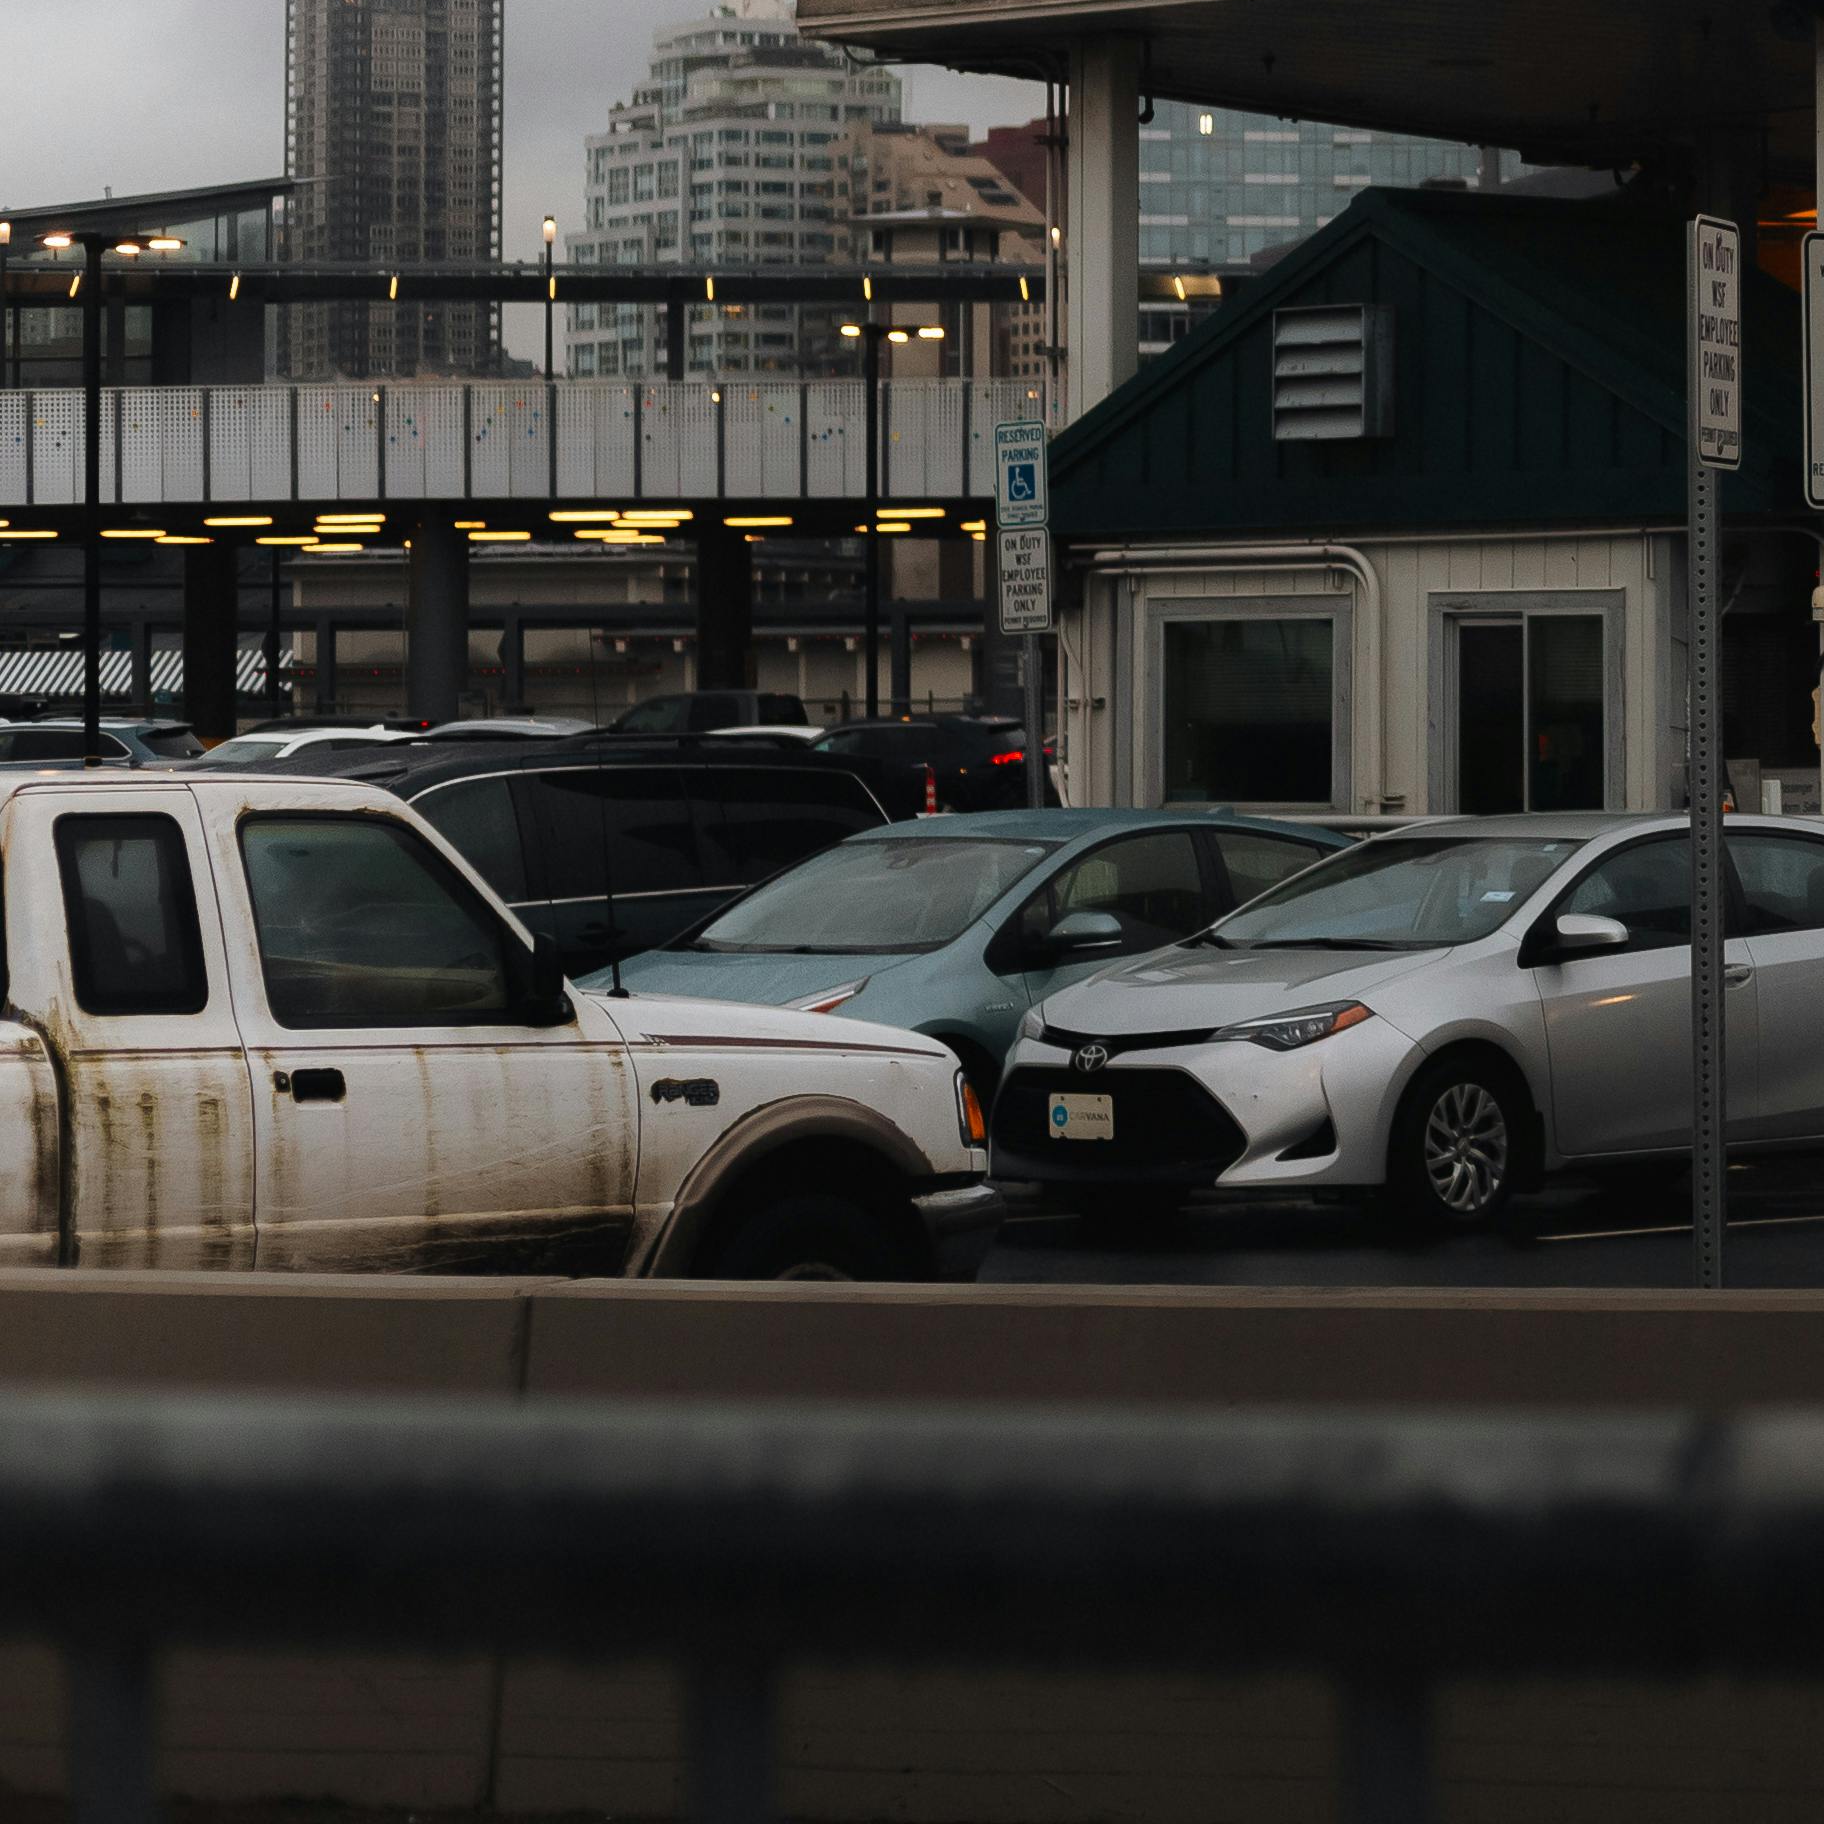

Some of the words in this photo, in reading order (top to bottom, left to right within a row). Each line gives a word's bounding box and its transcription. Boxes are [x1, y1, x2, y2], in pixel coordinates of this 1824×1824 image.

[1700, 314, 1738, 347] EMPLOYEE
[1703, 350, 1735, 382] PARKING
[1710, 388, 1729, 418] ONLY
[998, 427, 1042, 444] RESERVED
[1001, 447, 1039, 463] PARKING
[1004, 538, 1017, 551] ON
[1019, 535, 1041, 549] DUTY
[1015, 553, 1032, 565] WSF
[1002, 567, 1046, 582] EMPLOYEE
[1006, 583, 1043, 598] PARKING
[1013, 599, 1036, 613] ONLY
